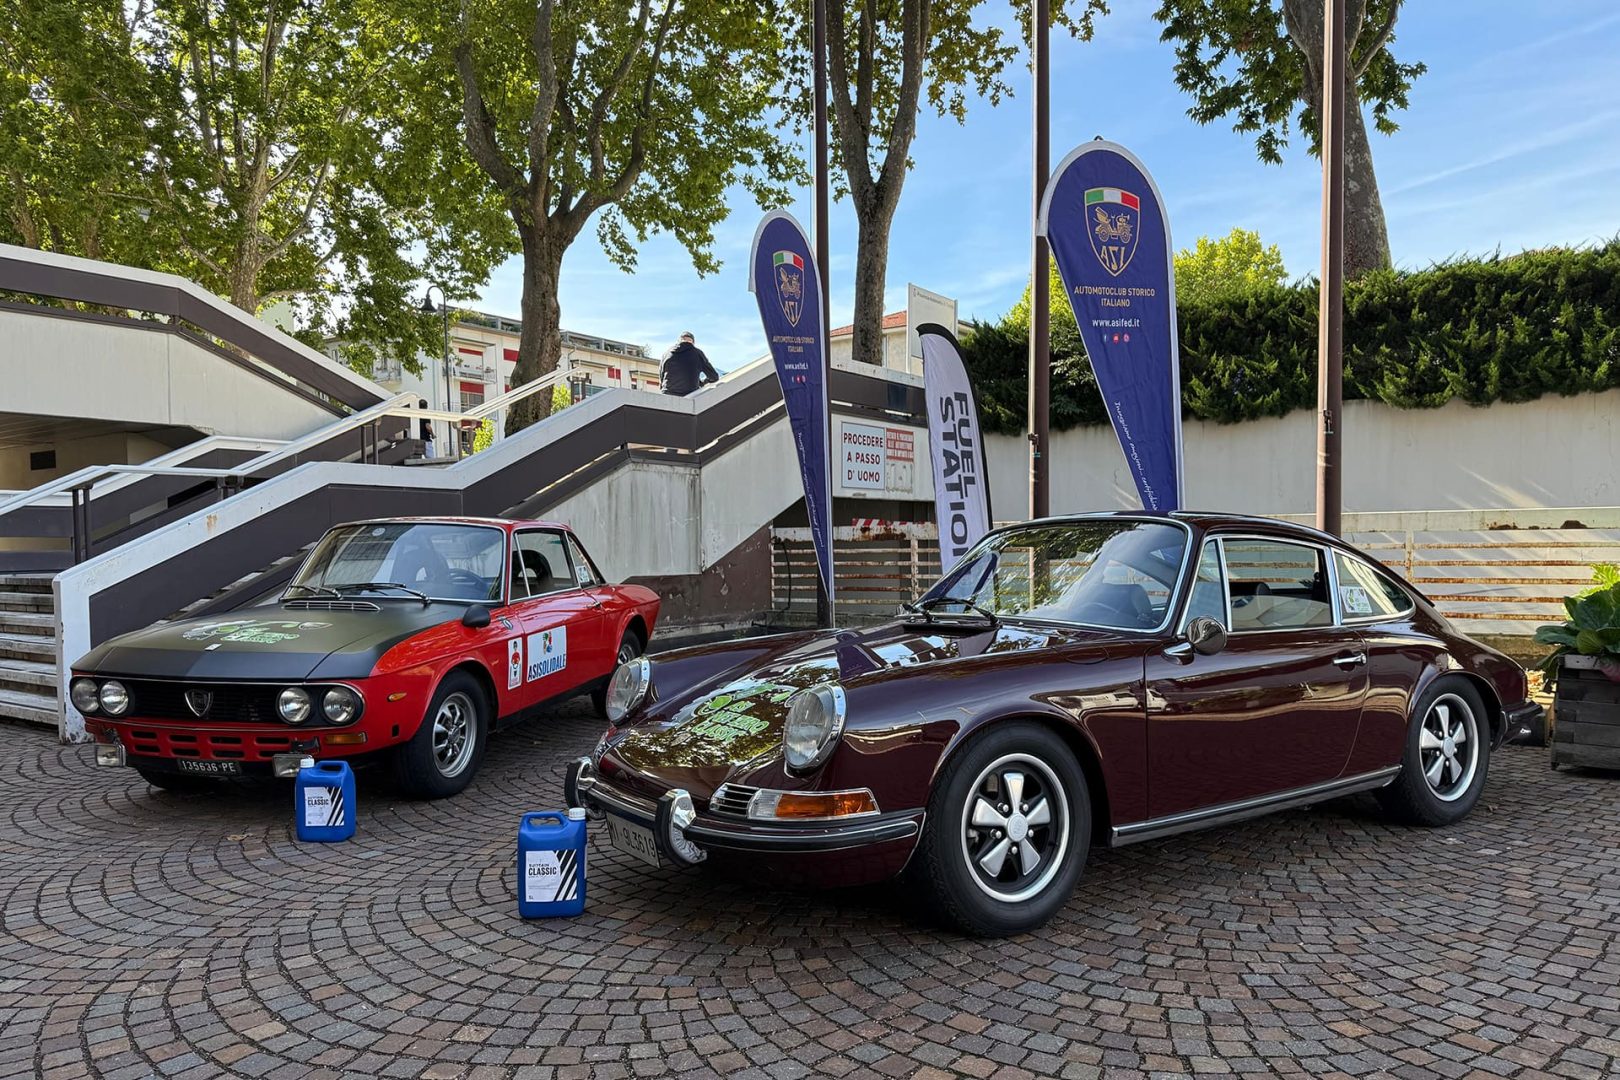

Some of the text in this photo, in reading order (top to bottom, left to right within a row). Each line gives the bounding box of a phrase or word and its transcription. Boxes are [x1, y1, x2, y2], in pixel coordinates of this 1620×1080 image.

[1100, 246, 1125, 271] ASI
[1074, 286, 1155, 296] AUTOMOTOCLUB STORICO
[1101, 299, 1130, 307] ITALIANO
[1092, 319, 1140, 328] www.asifed.it
[844, 433, 884, 448] PROCEDERE
[954, 391, 976, 497] FUEL
[847, 451, 881, 465] A PASSO
[858, 471, 880, 482] UOMO
[528, 654, 566, 681] ASISOLIDALE
[182, 760, 236, 772] 135636 PE
[528, 867, 557, 876] CLASSIC
